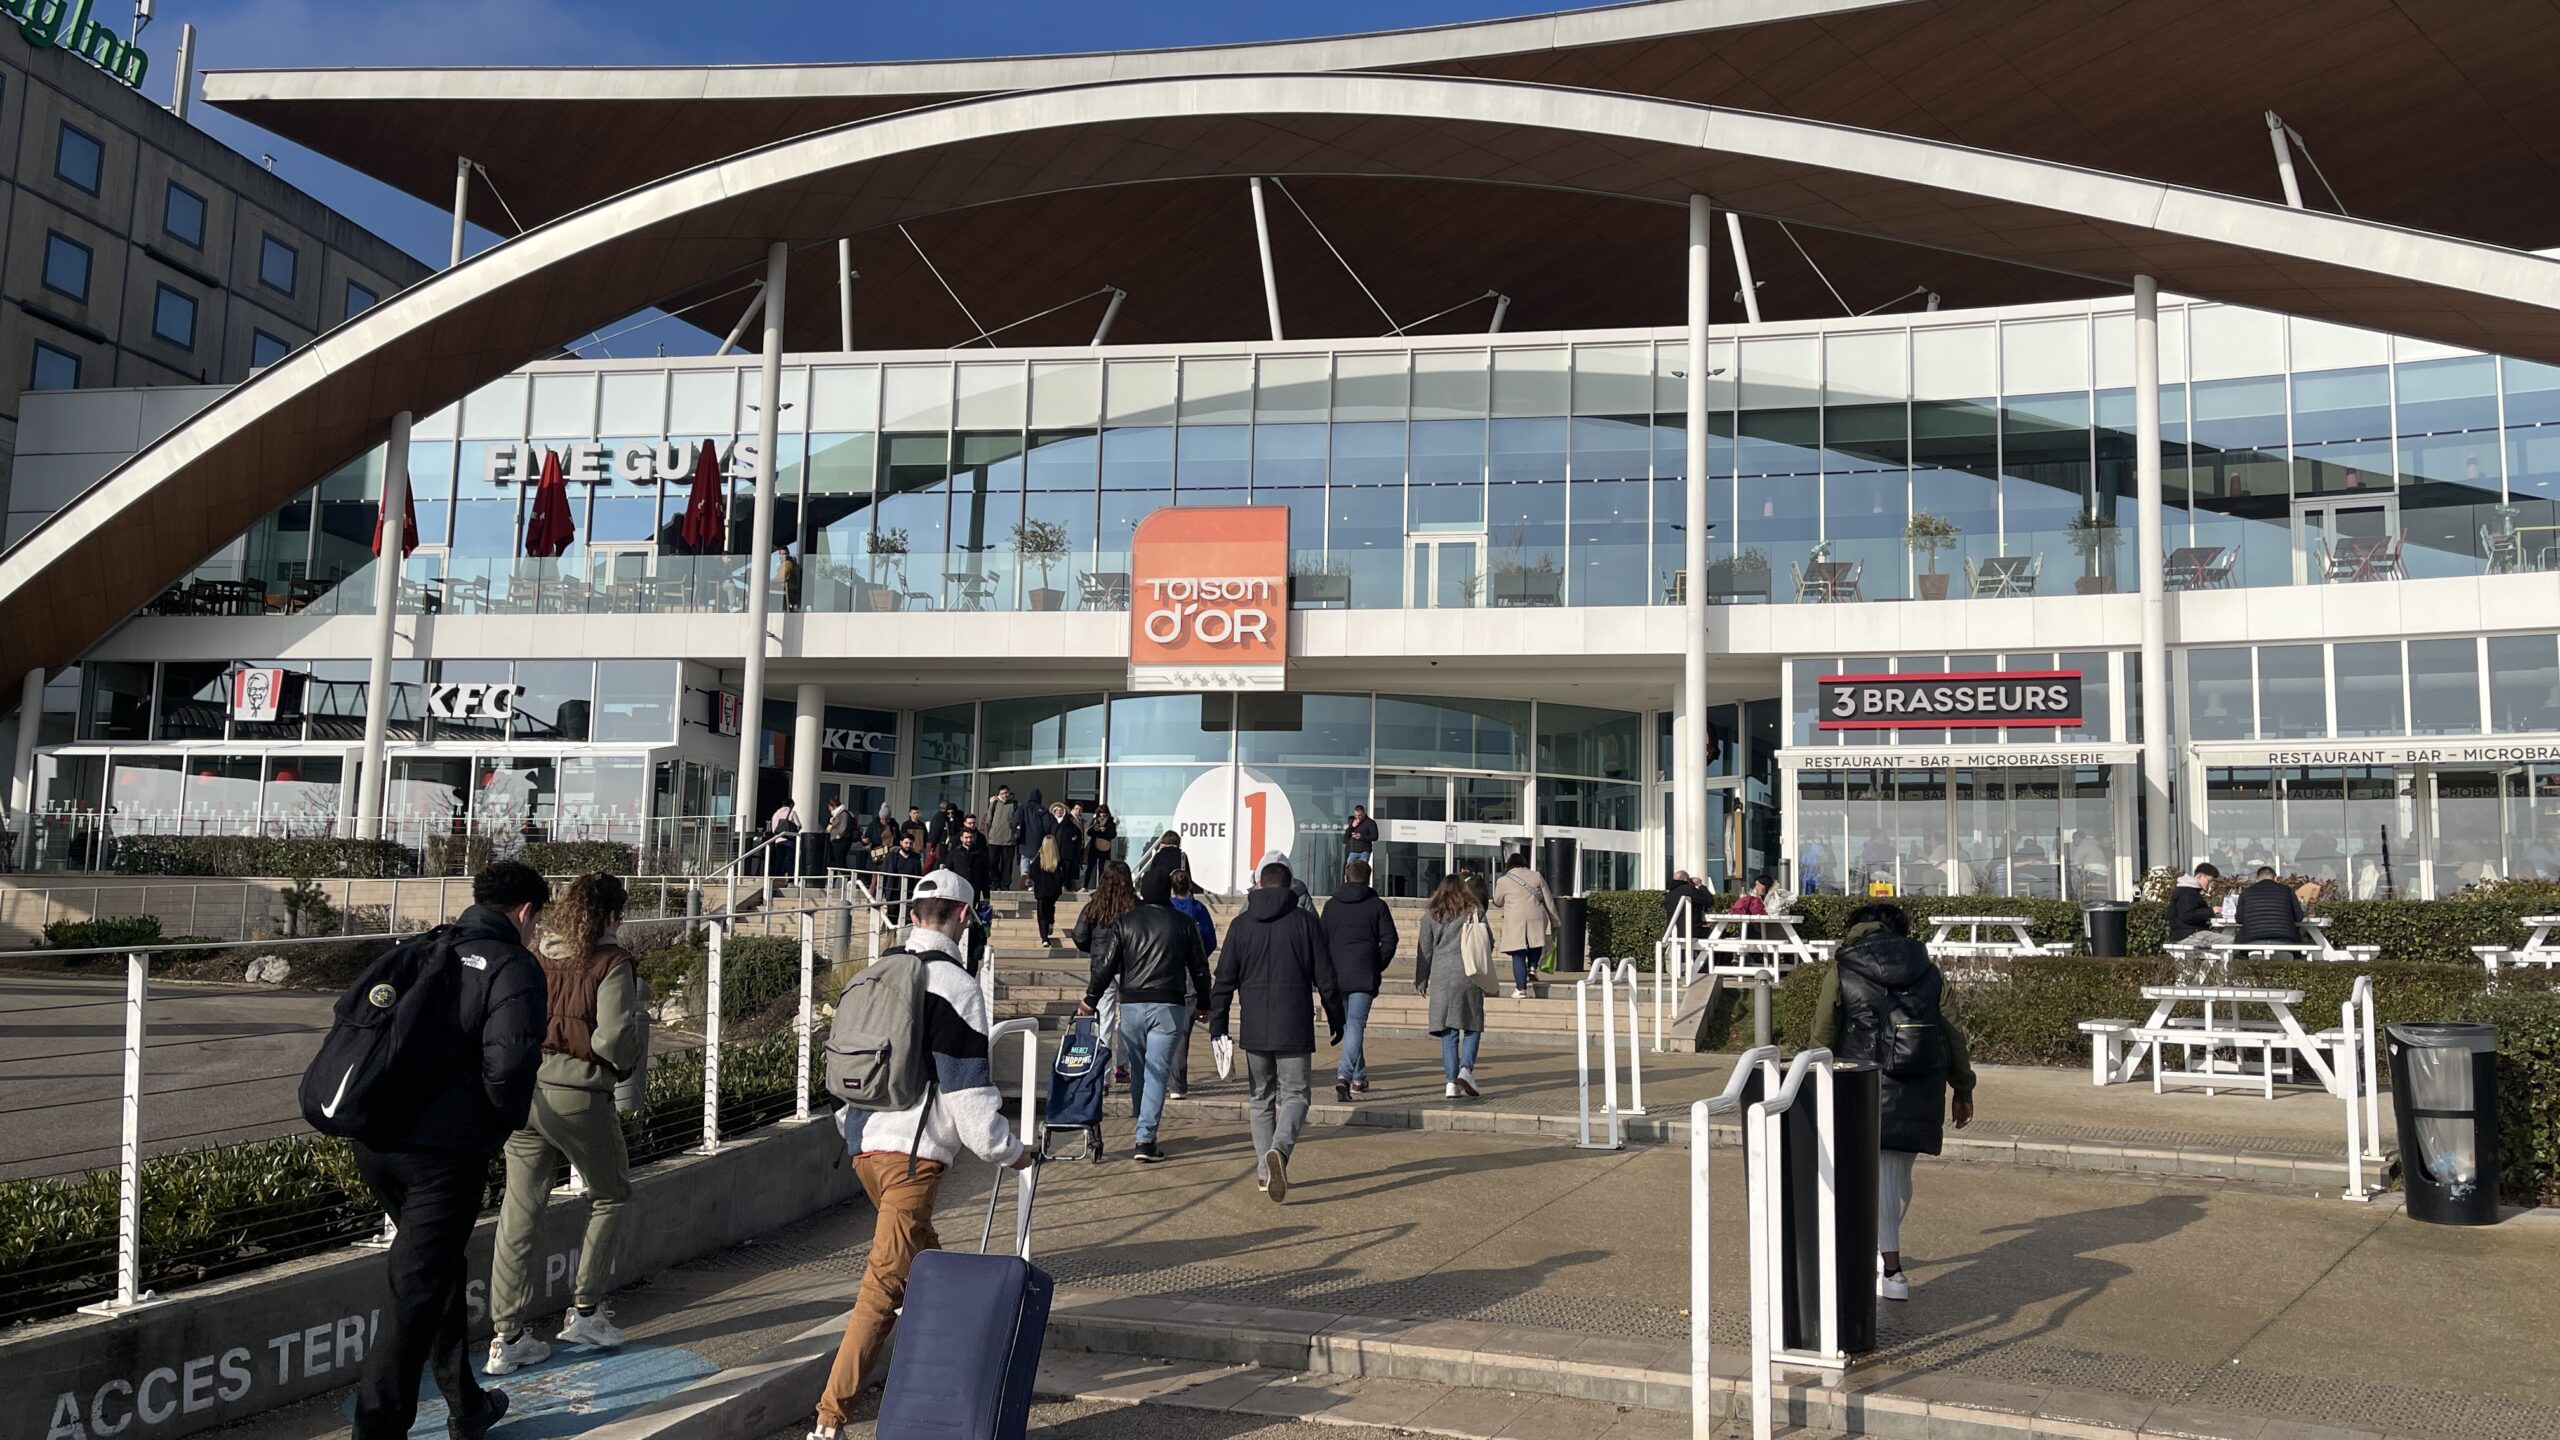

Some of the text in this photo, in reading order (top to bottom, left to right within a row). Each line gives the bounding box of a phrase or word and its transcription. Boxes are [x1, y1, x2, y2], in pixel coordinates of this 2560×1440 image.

[415, 682, 517, 719] KFC
[1832, 685, 2069, 717] 3 BRASSEURS
[822, 728, 882, 753] KFC
[1805, 756, 1903, 768] RESTAURANT
[1921, 756, 1950, 767] BAR
[1968, 753, 2105, 766] MICROBRASSERIE
[2269, 751, 2385, 764] RESTAURANT
[2406, 750, 2441, 762] BAR
[2464, 747, 2560, 760] MICROBRA
[1181, 791, 1267, 871] PORTE 1
[1061, 1054, 1092, 1065] SHOPPING
[46, 1347, 251, 1440] ACCES
